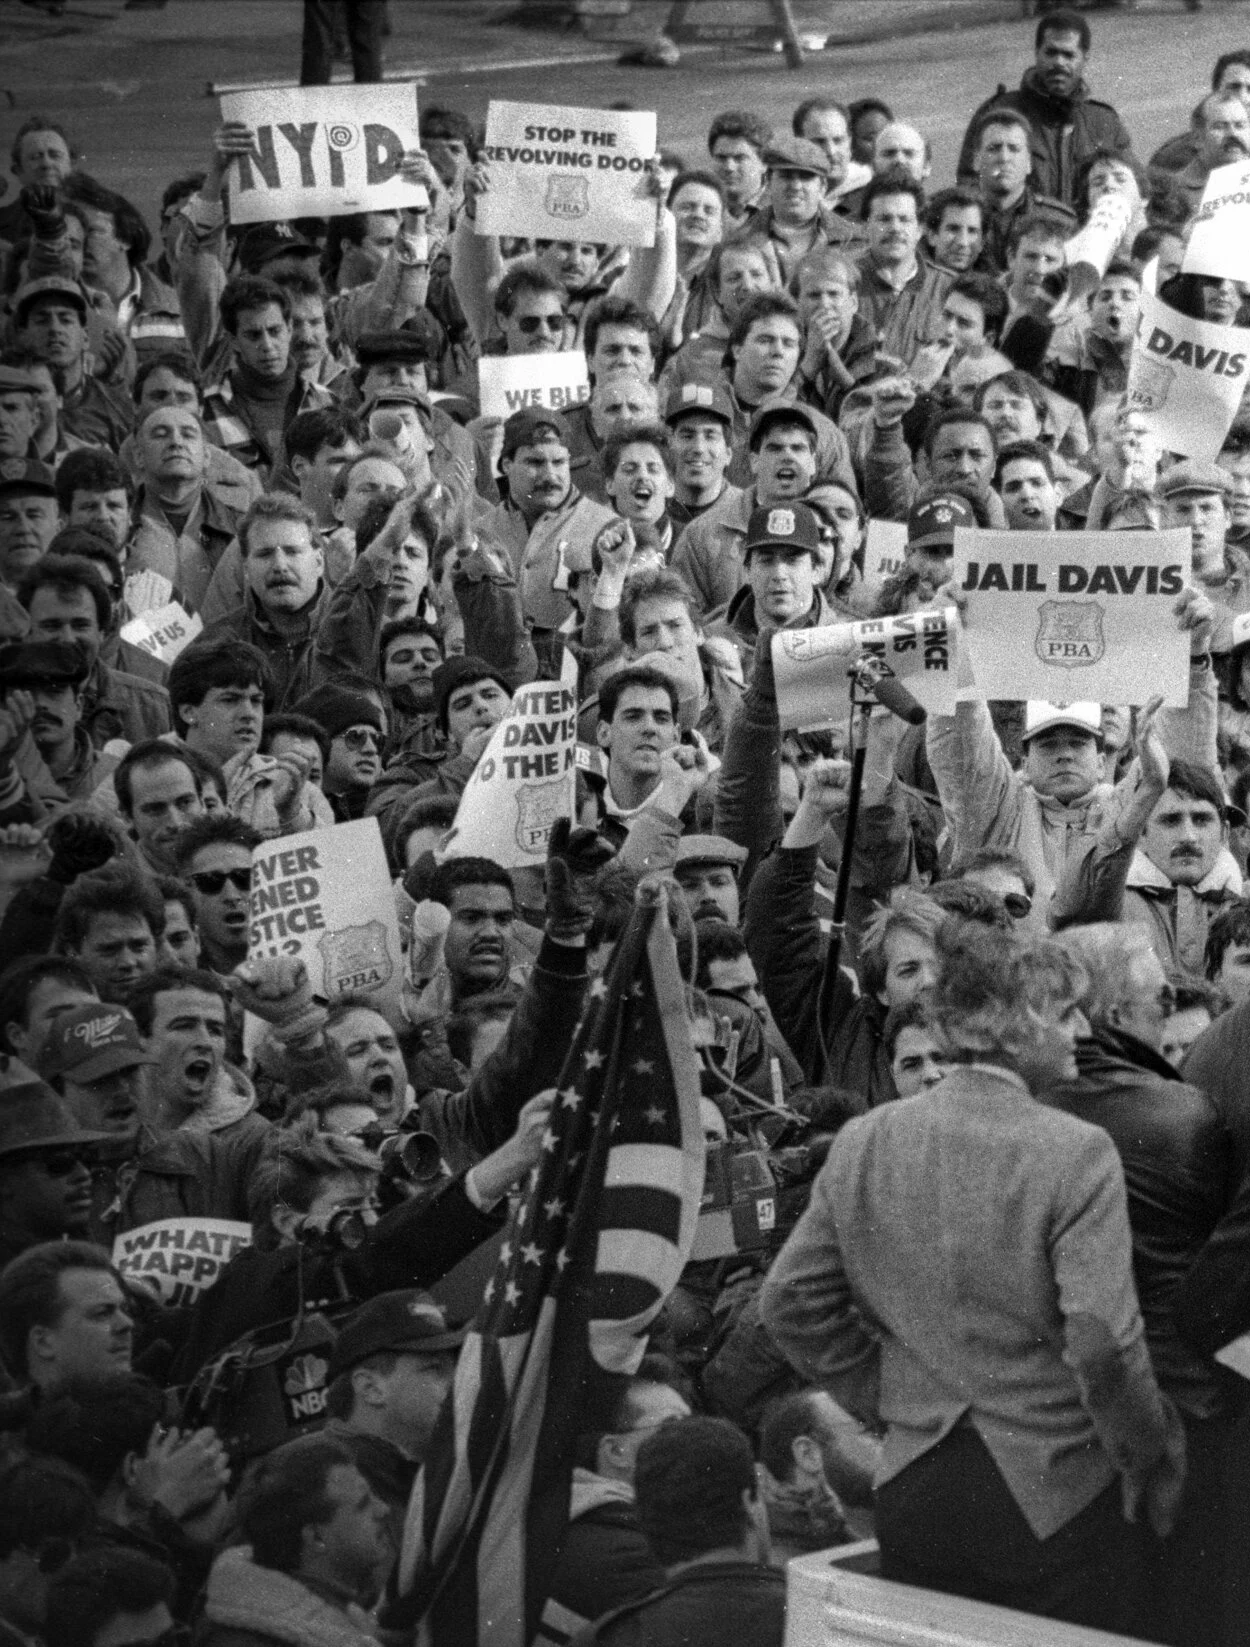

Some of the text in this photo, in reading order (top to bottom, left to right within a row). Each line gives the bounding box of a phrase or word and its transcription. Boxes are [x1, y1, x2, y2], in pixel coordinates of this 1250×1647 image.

[524, 125, 617, 147] STOP THE
[237, 121, 404, 192] NYPD
[485, 146, 592, 168] REVOLVING
[1147, 326, 1248, 379] DAVIS
[504, 388, 543, 410] WE
[962, 562, 1184, 595] JAIL DAVIS
[163, 621, 186, 641] US
[1048, 643, 1092, 657] PBA
[503, 715, 577, 748] DAVIS
[503, 752, 560, 780] THE
[338, 969, 381, 992] PBA
